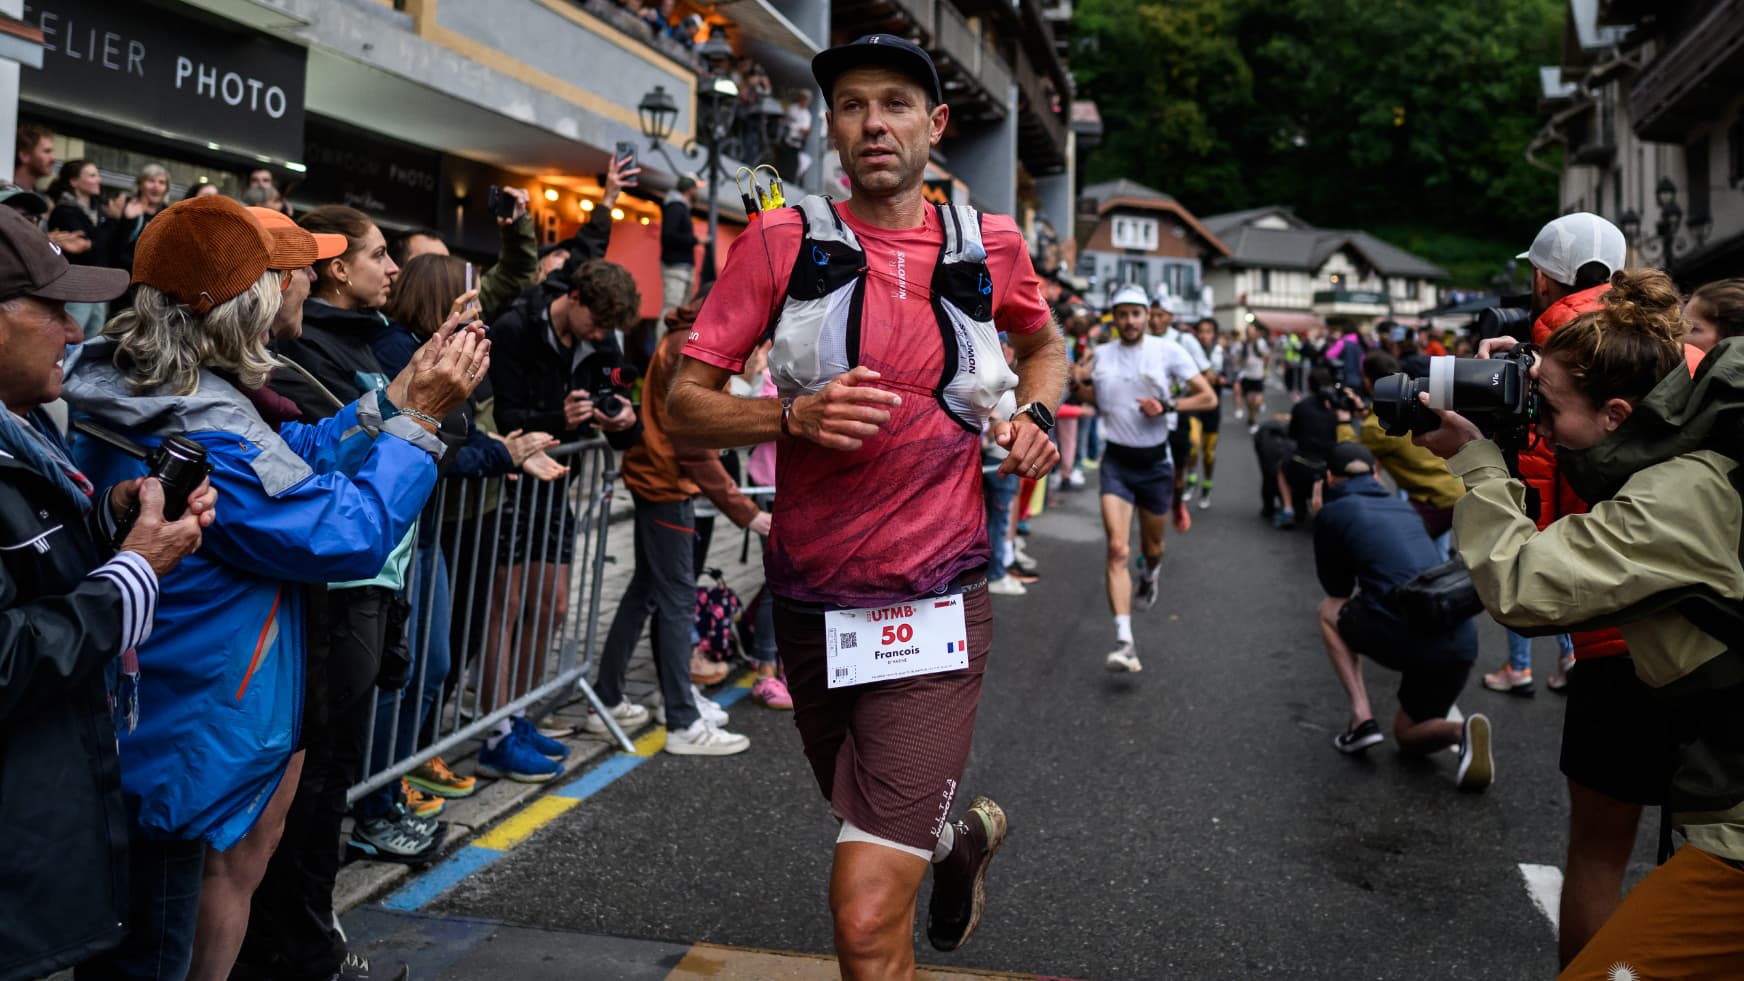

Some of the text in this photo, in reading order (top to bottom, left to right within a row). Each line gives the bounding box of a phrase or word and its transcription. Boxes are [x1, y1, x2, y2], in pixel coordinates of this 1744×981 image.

[24, 4, 287, 118] ELIER PHOTO
[389, 164, 436, 192] PHOTO
[872, 605, 914, 621] UTMB
[881, 623, 914, 646] 50
[874, 645, 920, 660] Francois
[930, 778, 953, 835] ULTRA
